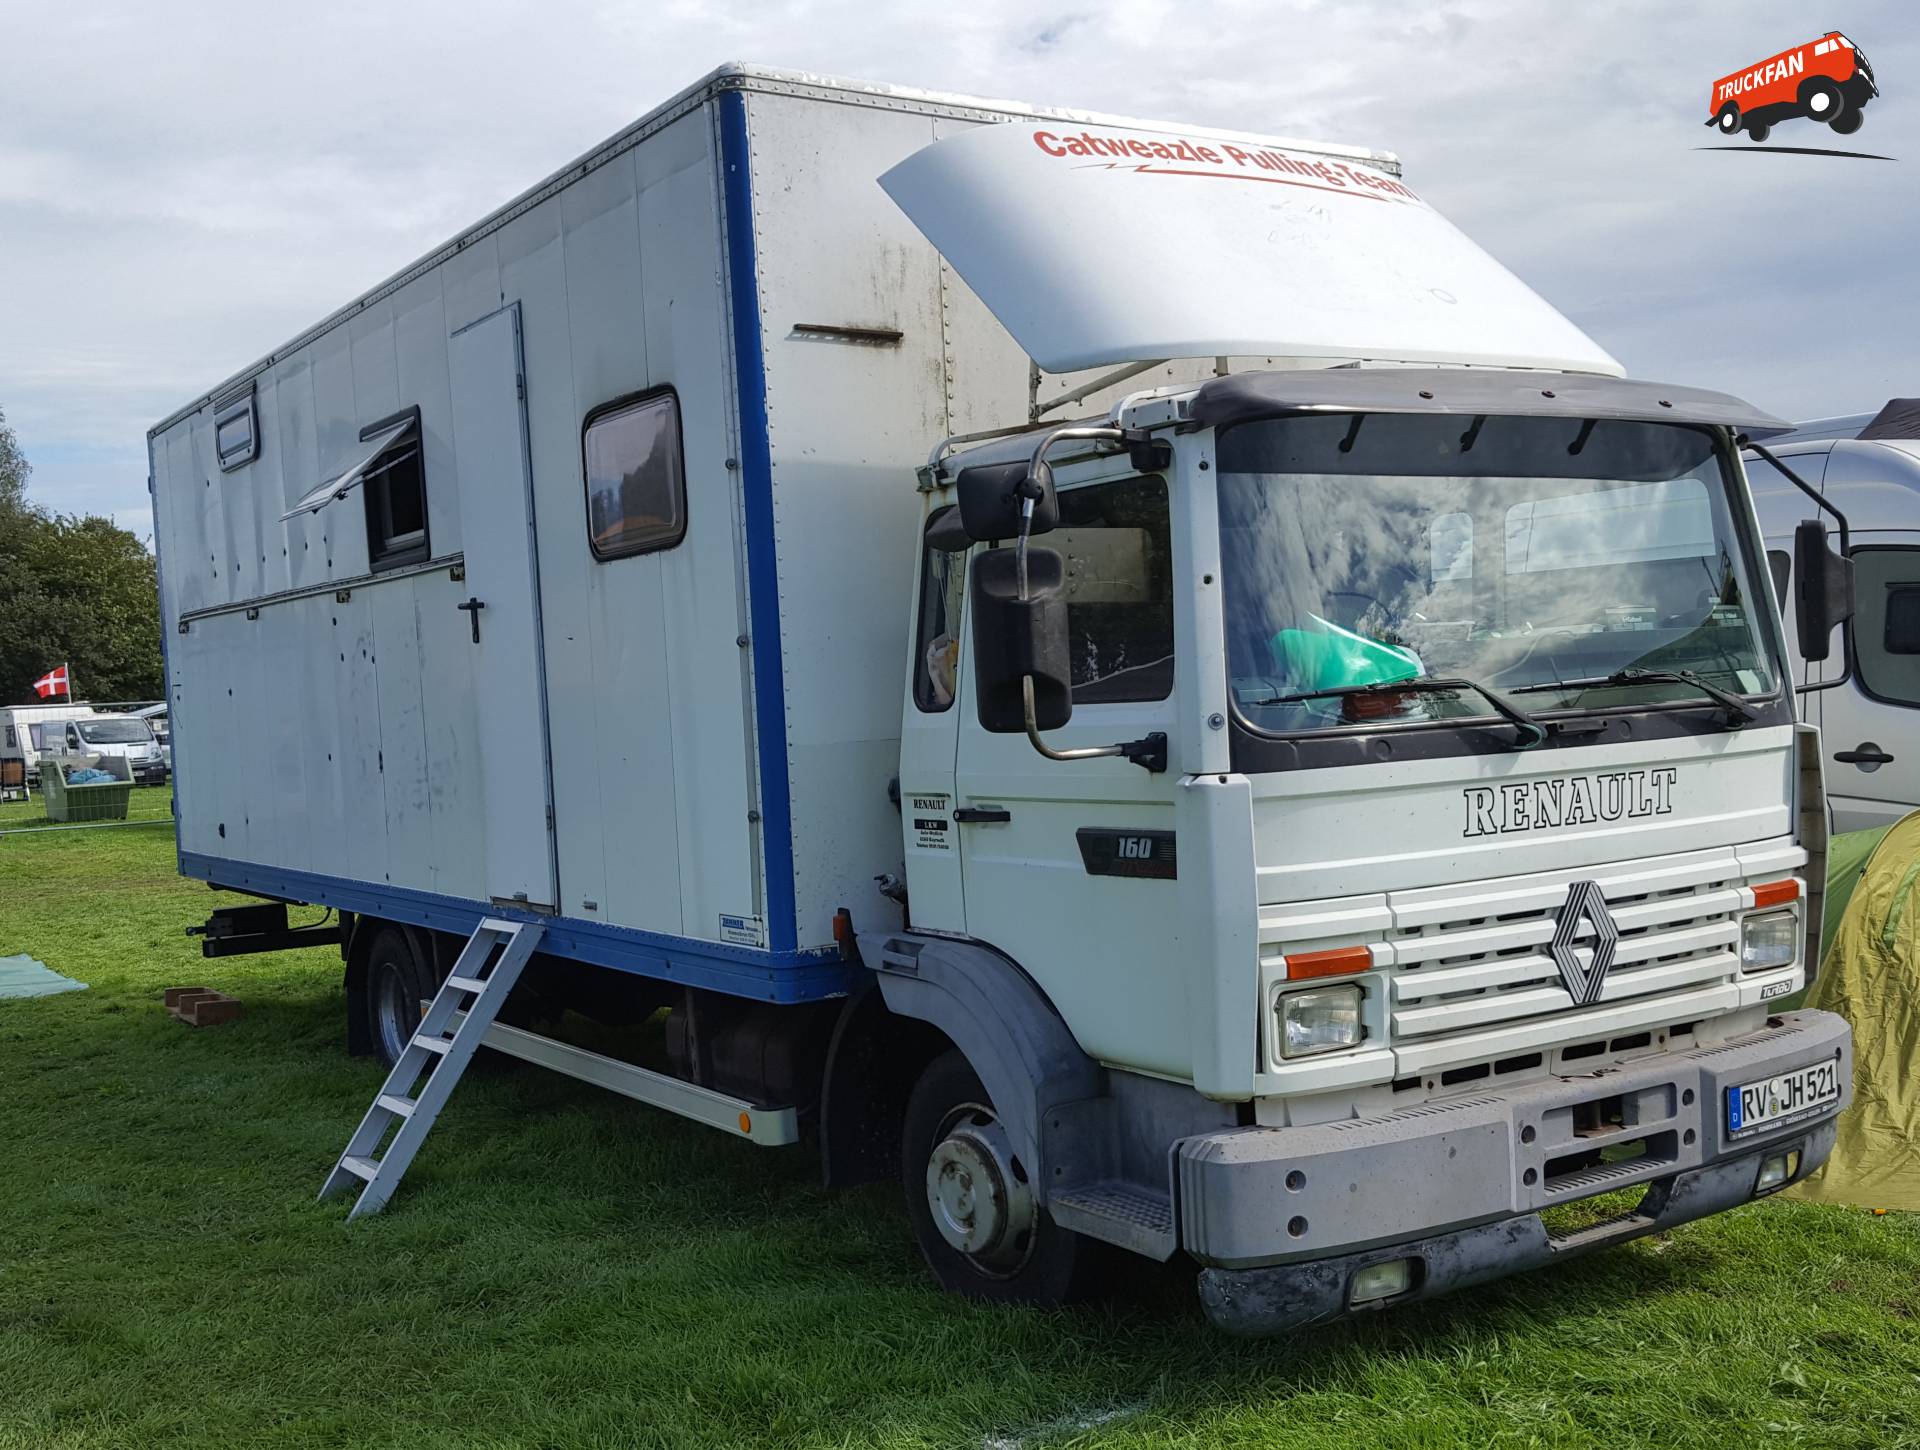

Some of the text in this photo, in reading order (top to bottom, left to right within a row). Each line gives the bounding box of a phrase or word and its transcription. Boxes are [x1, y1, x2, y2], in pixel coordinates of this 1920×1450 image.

[1033, 131, 1421, 202] Catweazle Pulling-Team
[913, 799, 946, 810] RENAULT
[1464, 768, 1677, 837] RENAULT
[1118, 837, 1152, 859] 160
[1762, 980, 1791, 999] TURBO
[1733, 1112, 1738, 1122] D
[1742, 1084, 1767, 1122] RV
[1780, 1074, 1804, 1110] JH
[1807, 1063, 1836, 1102] 521
